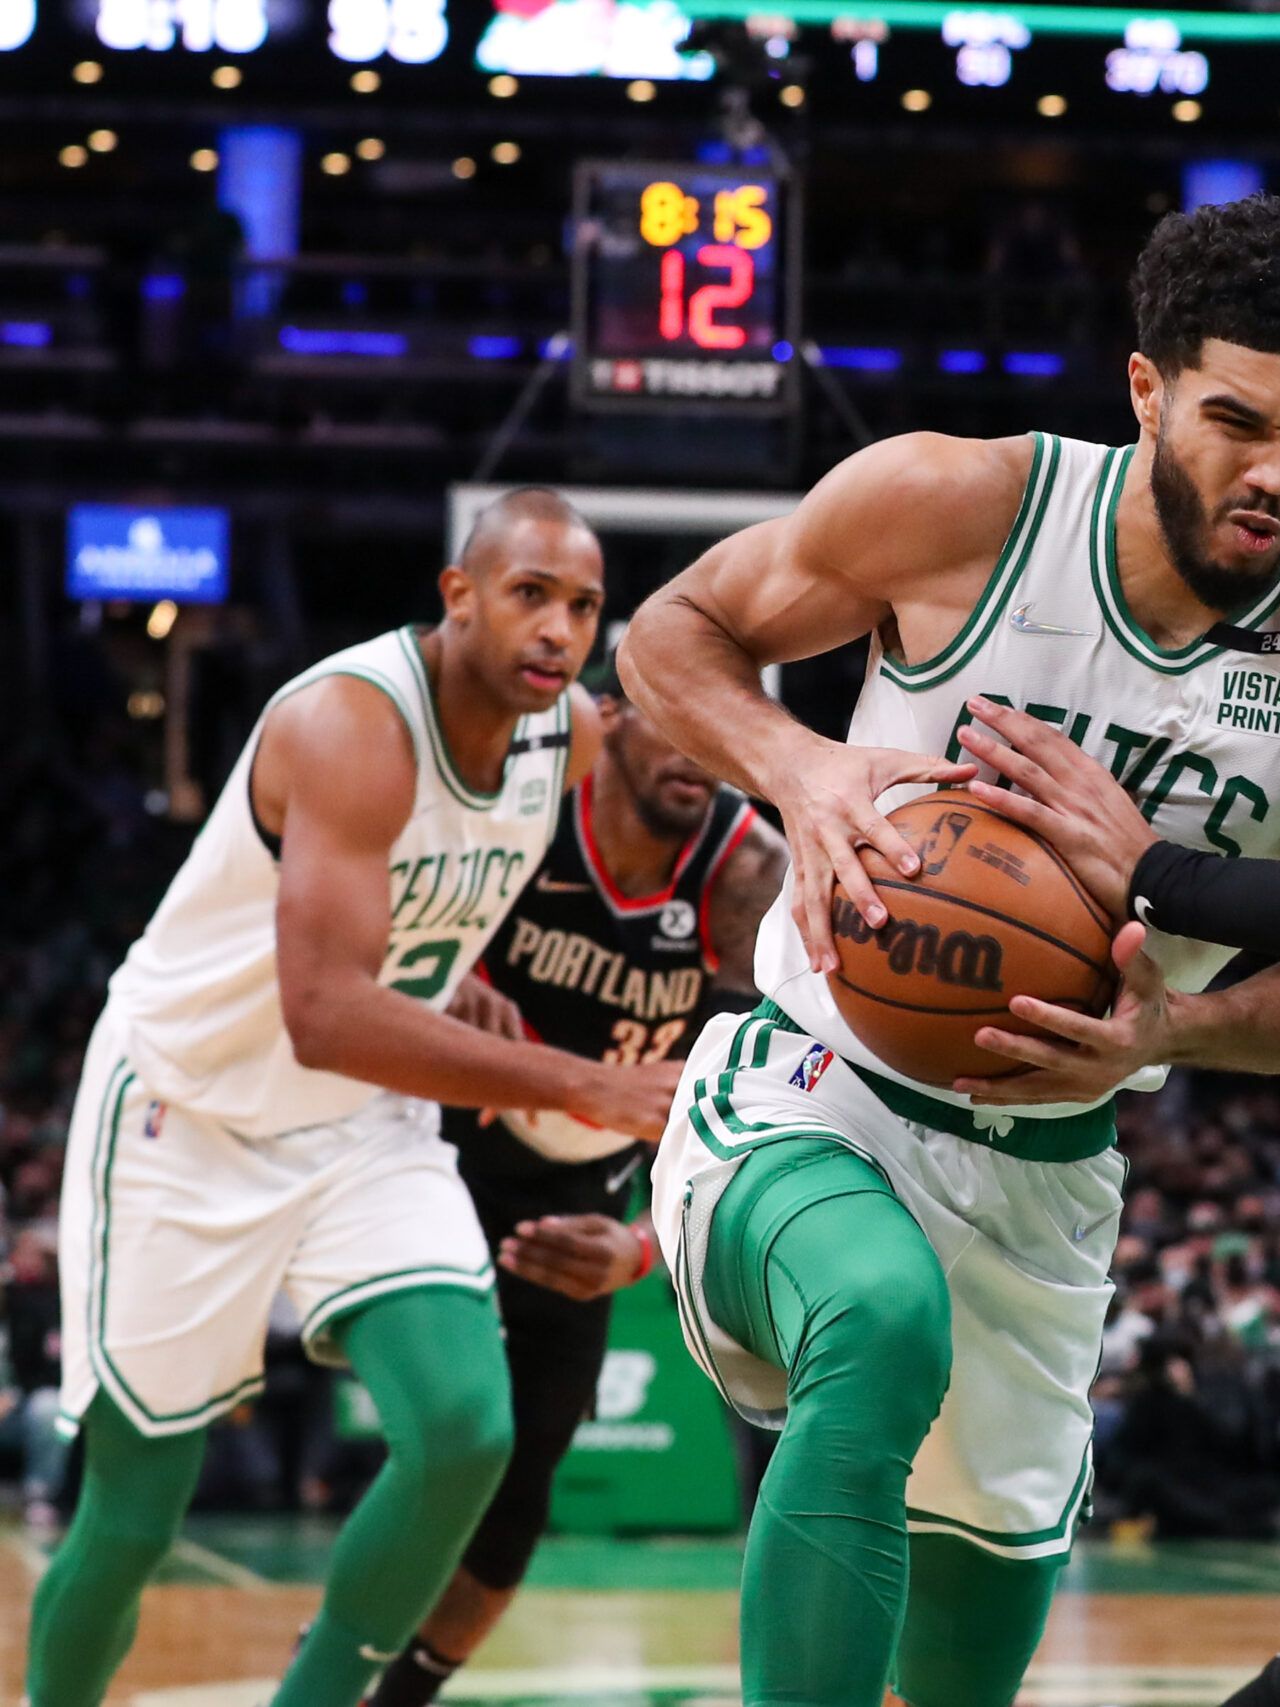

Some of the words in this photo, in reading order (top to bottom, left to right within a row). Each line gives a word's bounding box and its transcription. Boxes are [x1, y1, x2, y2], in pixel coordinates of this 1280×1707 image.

[640, 182, 772, 250] 8:15
[658, 245, 754, 349] 12
[937, 692, 1270, 859] CTICS
[506, 916, 703, 1018] PORTLAND
